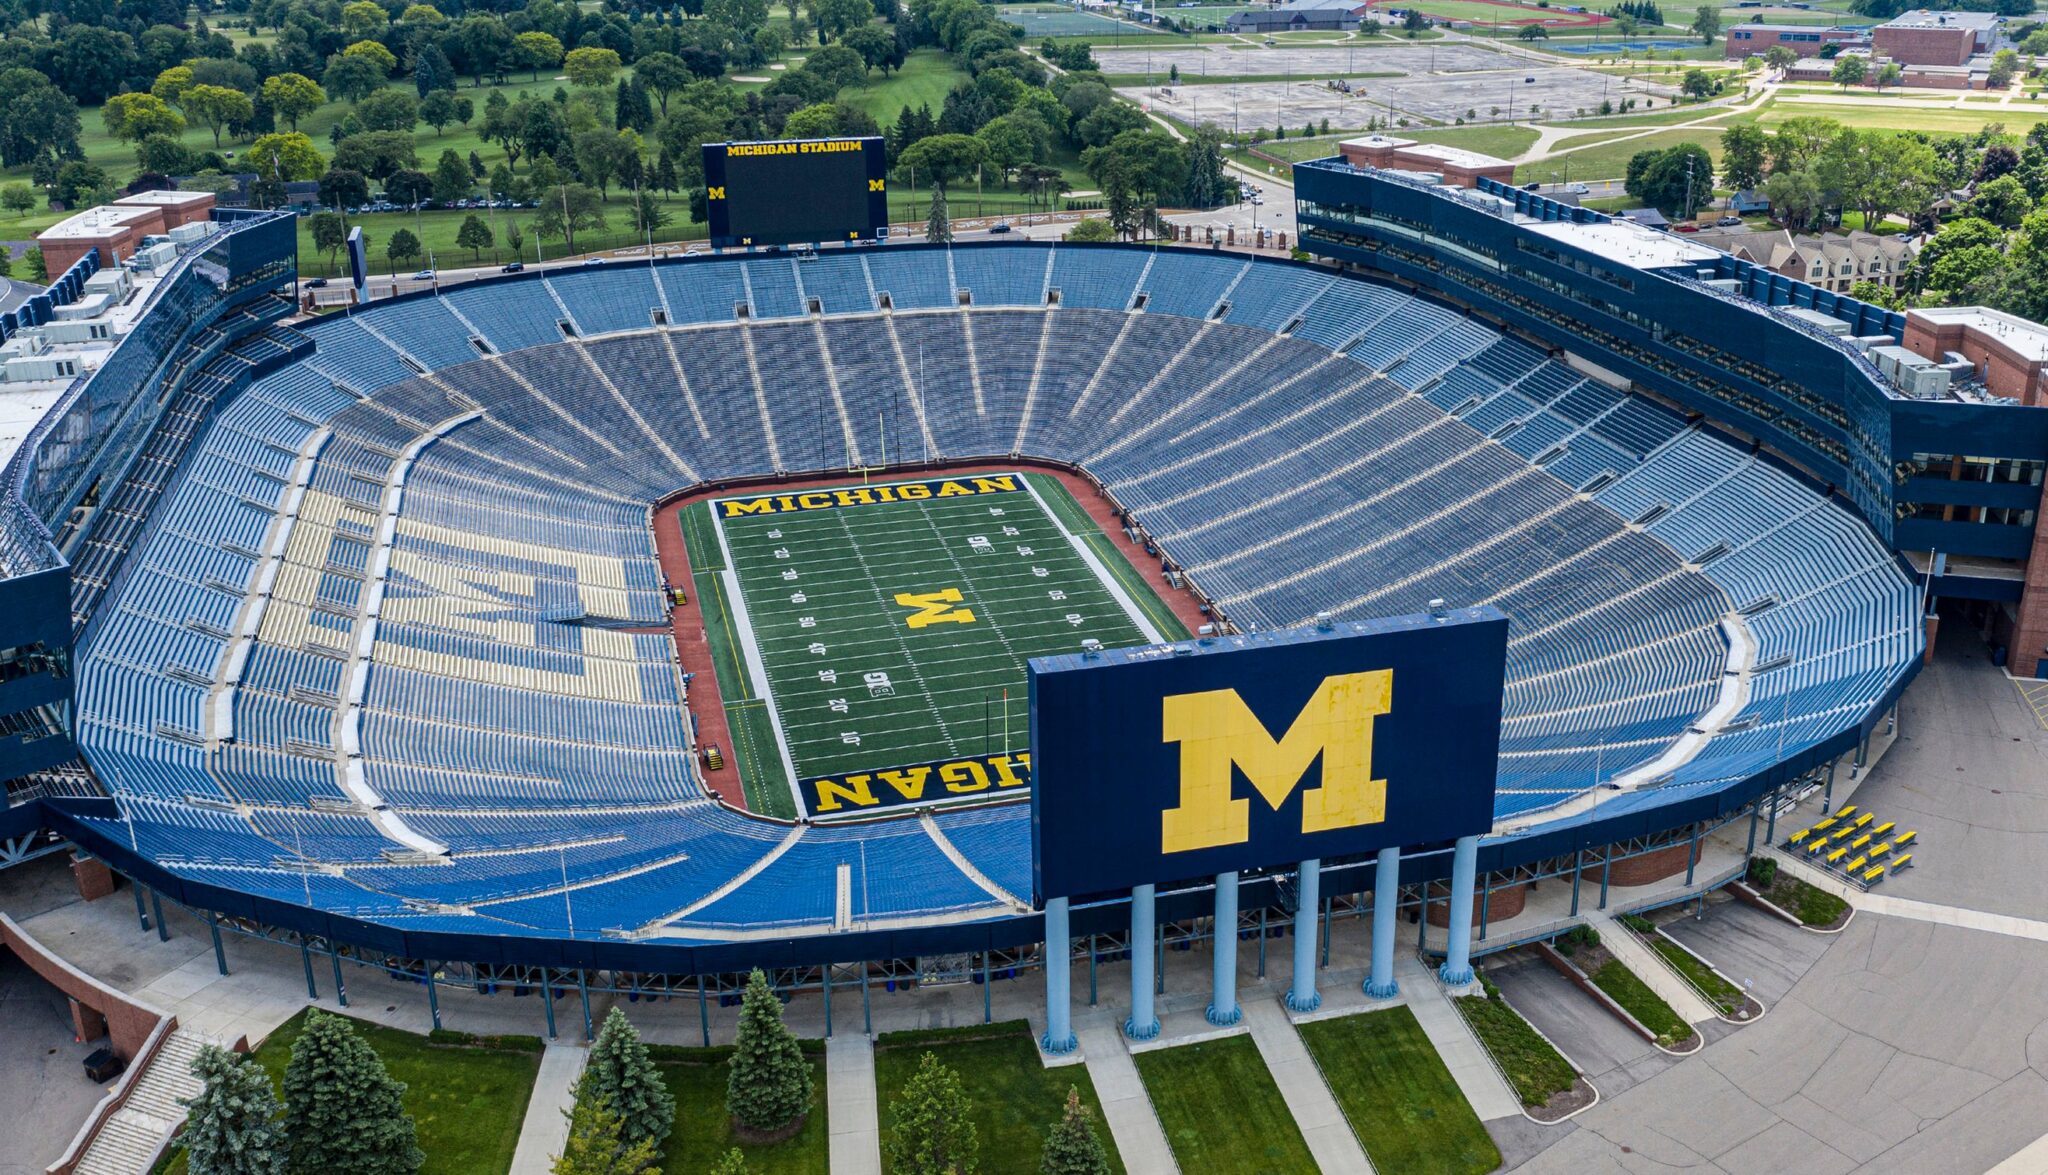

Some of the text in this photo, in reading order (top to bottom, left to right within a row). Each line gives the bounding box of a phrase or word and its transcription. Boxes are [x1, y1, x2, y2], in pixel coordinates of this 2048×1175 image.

[727, 141, 862, 156] MICHIGAN STADIUM
[869, 179, 885, 192] M
[708, 187, 726, 199] M
[743, 237, 751, 245] M
[850, 231, 858, 239] M
[722, 476, 1018, 517] MICHIGAN
[1048, 590, 1067, 600] 50
[894, 587, 977, 629] M
[798, 616, 816, 628] 50
[808, 642, 826, 654] 40
[818, 669, 837, 681] 30
[828, 698, 848, 711] 20
[841, 731, 861, 744] 10
[1162, 668, 1394, 855] M
